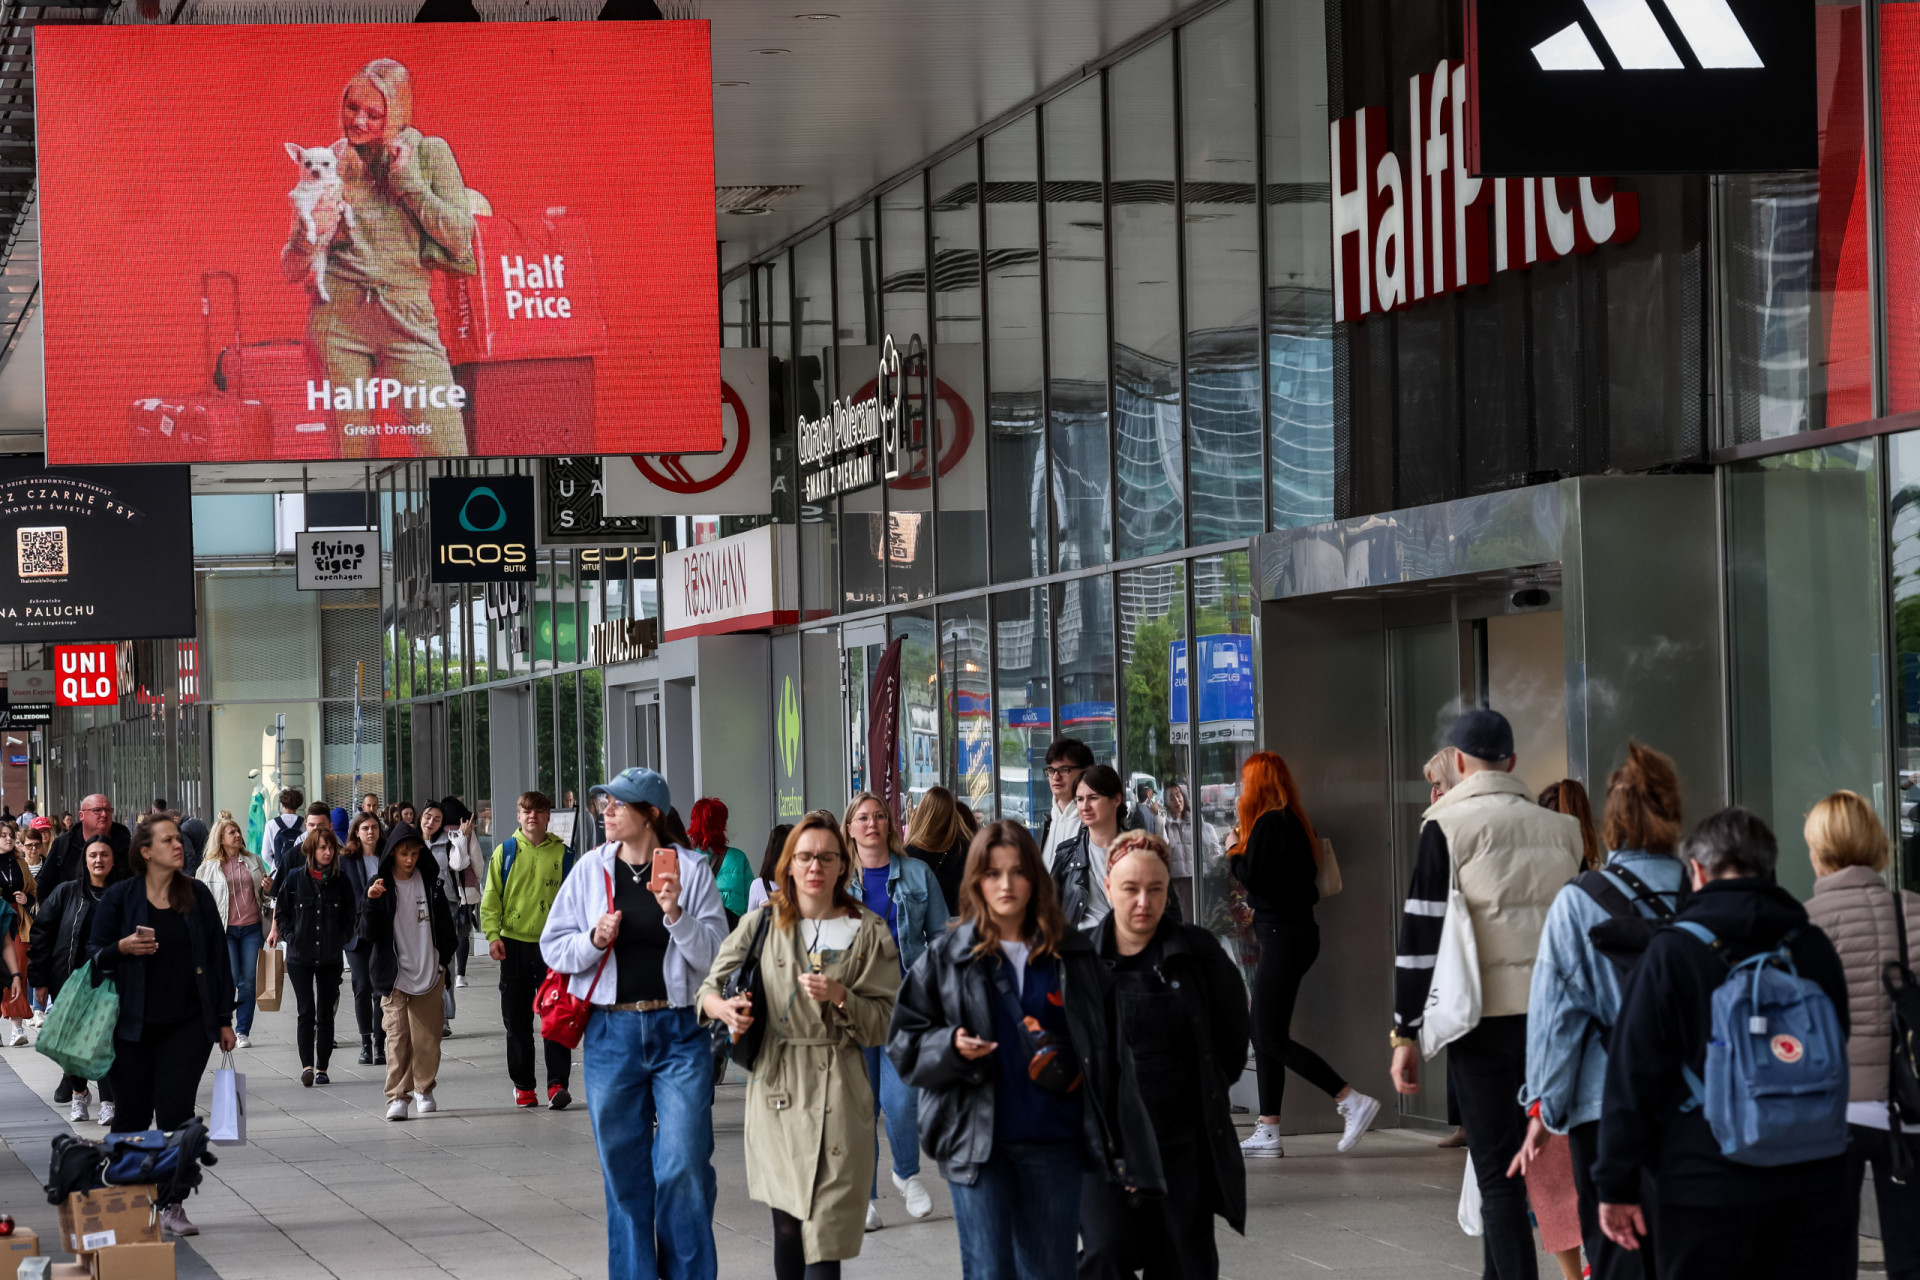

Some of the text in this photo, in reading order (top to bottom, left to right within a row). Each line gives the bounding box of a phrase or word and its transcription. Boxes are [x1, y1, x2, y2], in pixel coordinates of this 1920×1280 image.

[501, 254, 565, 289] Half
[505, 289, 572, 319] Price
[306, 377, 467, 411] HalfPrice
[344, 422, 432, 436] Great brands
[806, 469, 829, 503] SMAKI
[837, 454, 874, 492] PIEKARNI
[5, 503, 92, 516] NOWYM ŚWIETLE
[27, 489, 95, 504] CZARNE
[106, 501, 135, 519] PSY
[311, 540, 365, 559] flying
[440, 543, 527, 567] IQOS
[314, 556, 362, 574] tiger
[503, 564, 527, 573] BUTIK
[25, 605, 95, 617] PALUCHU
[62, 652, 106, 673] UNI
[63, 677, 111, 702] QLO
